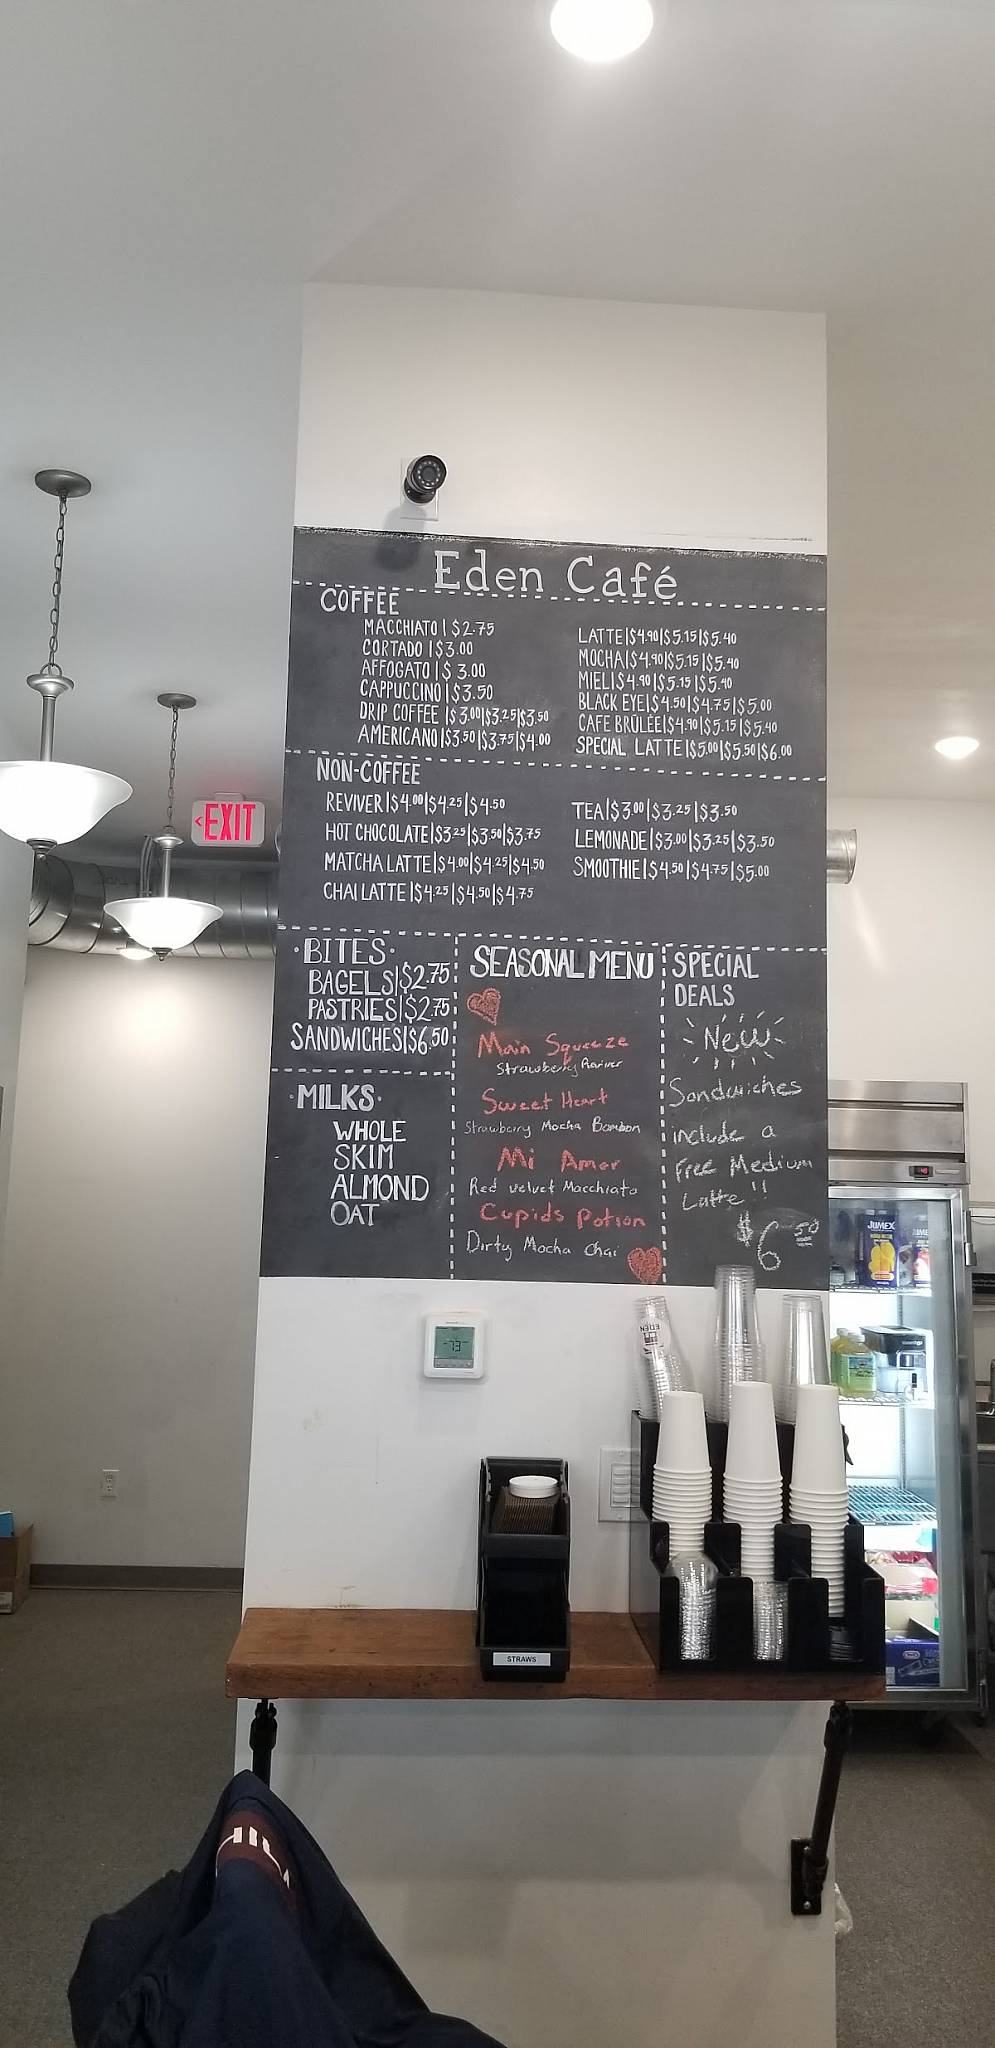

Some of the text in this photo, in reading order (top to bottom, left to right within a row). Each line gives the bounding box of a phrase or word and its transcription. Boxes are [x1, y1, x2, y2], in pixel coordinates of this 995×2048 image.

[434, 549, 677, 599] Eden Café
[321, 588, 399, 615] COFFEE
[364, 619, 494, 637] MACCHIATO $2.75
[578, 628, 622, 645] LATTE
[363, 639, 473, 659] CORTADO $3.00
[579, 649, 625, 669] MOCHA
[361, 660, 429, 679] AFFOGATO
[579, 672, 610, 690] MIEL
[360, 680, 493, 703] CAPPUCCINO $3.50
[579, 692, 617, 711] BLACK
[623, 694, 646, 711] EYE
[360, 702, 387, 722] DRIP
[393, 703, 439, 724] COFFEE
[578, 714, 610, 732] CAFE
[358, 725, 437, 748] AMERICANO
[576, 736, 626, 756] SPECIAL
[635, 739, 682, 756] LATTE
[317, 758, 420, 784] NON-COFFEE
[326, 792, 383, 813] REVIVER
[571, 802, 604, 820] TEA
[204, 803, 255, 840] EXIT
[326, 823, 352, 841] HOT
[355, 824, 428, 843] CHOCOLATE
[575, 829, 647, 850] LEMONADE
[324, 852, 383, 872] MATCHA
[387, 855, 431, 872] LATTE
[573, 857, 640, 879] SMOOTHIE
[324, 882, 357, 901] CHAI
[361, 883, 406, 901] LATTE
[470, 945, 654, 980] SEASONAL MENU
[672, 952, 759, 979] SPECIAL
[309, 970, 393, 995] BAGELS
[675, 983, 735, 1007] DEALS
[308, 998, 397, 1021] PASTRIES
[290, 1022, 402, 1051] SANDWICHES
[478, 1032, 630, 1065] Main Squeeze
[482, 1088, 608, 1114] Sweet Heart
[669, 1075, 802, 1107] Sandwiches
[333, 1120, 406, 1142] WHOLE
[542, 1120, 581, 1131] Mocha
[672, 1120, 777, 1145] include a
[334, 1144, 393, 1170] SKIM
[497, 1147, 621, 1172] Mi Amor
[730, 1150, 812, 1178] Medium
[331, 1174, 429, 1201] ALMOND
[469, 1177, 497, 1196] Red
[563, 1179, 637, 1197] Macchiato
[331, 1201, 380, 1226] OAT
[480, 1201, 564, 1228] Cupids
[867, 1220, 895, 1230] JUMEX
[467, 1230, 512, 1262] Dirty
[524, 1236, 571, 1254] Mocha
[506, 1655, 537, 1663] STRAWS
